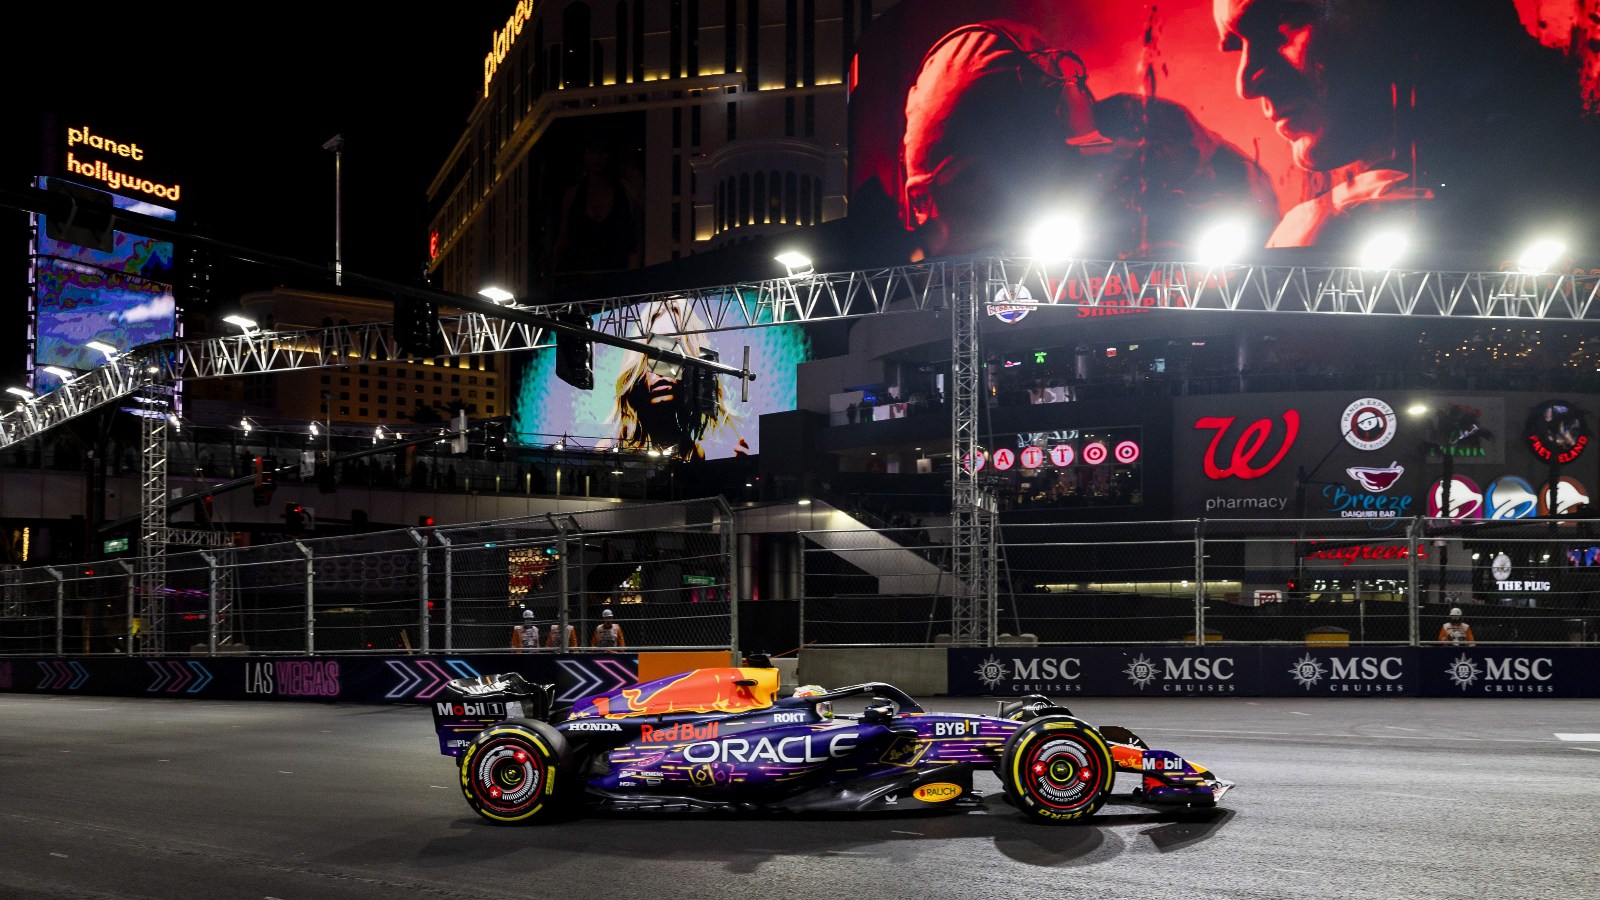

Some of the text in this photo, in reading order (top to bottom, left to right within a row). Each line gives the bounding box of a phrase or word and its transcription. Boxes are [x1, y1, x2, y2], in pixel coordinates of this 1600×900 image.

[67, 126, 144, 161] planet
[67, 151, 181, 201] hollywood
[1049, 272, 1141, 301] BUBBA
[1344, 402, 1365, 422] PANDA
[1345, 432, 1368, 449] HINESE
[1529, 435, 1588, 463] PRETELAND
[1206, 496, 1288, 511] pharmacy
[1322, 482, 1413, 530] Breeze
[1341, 510, 1396, 518] DAIQUIRI BAR
[1496, 581, 1551, 592] THE PLUG
[1012, 657, 1081, 680] MSC
[1163, 657, 1234, 680] MSC
[1329, 656, 1403, 680] MSC
[1484, 657, 1553, 681] MSC
[245, 661, 340, 696] LAS VEGAS
[1012, 684, 1082, 692] CRUISES
[1163, 684, 1235, 692] CRUISES
[1330, 684, 1404, 692] CRUISES
[1485, 684, 1554, 693] CRUISES
[437, 702, 502, 716] Mobil 1
[592, 697, 610, 716] 1
[774, 712, 806, 723] ROKT
[568, 722, 623, 732] HONDA
[641, 721, 720, 743] Red Bull
[935, 719, 980, 736] BYBIT
[683, 733, 860, 763] ORACLE
[1142, 757, 1183, 770] Mobil
[926, 786, 957, 797] RAUCH
